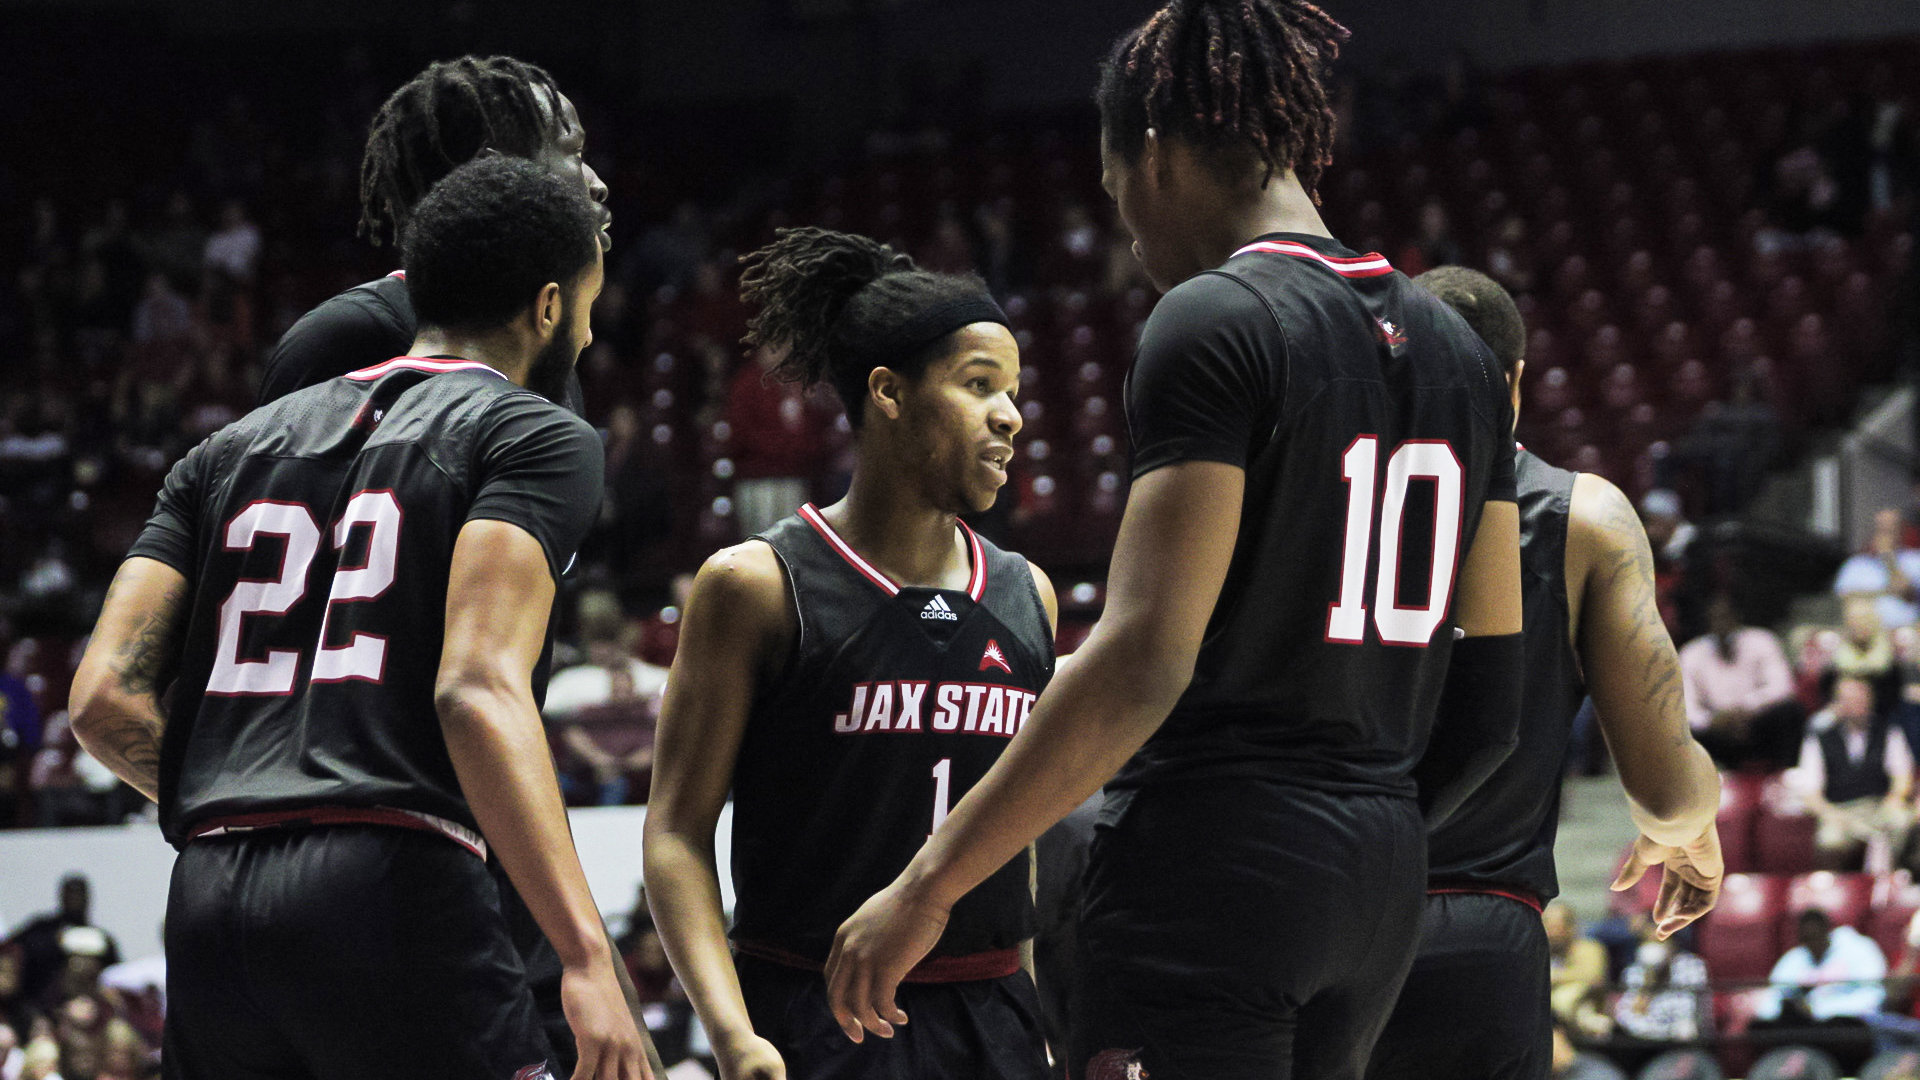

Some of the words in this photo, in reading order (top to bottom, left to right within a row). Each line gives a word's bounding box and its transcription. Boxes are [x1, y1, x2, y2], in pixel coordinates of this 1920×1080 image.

[1324, 433, 1466, 648] 10
[205, 488, 404, 697] 22
[920, 609, 958, 621] adidas
[833, 680, 930, 733] JAX
[926, 758, 951, 842] 1
